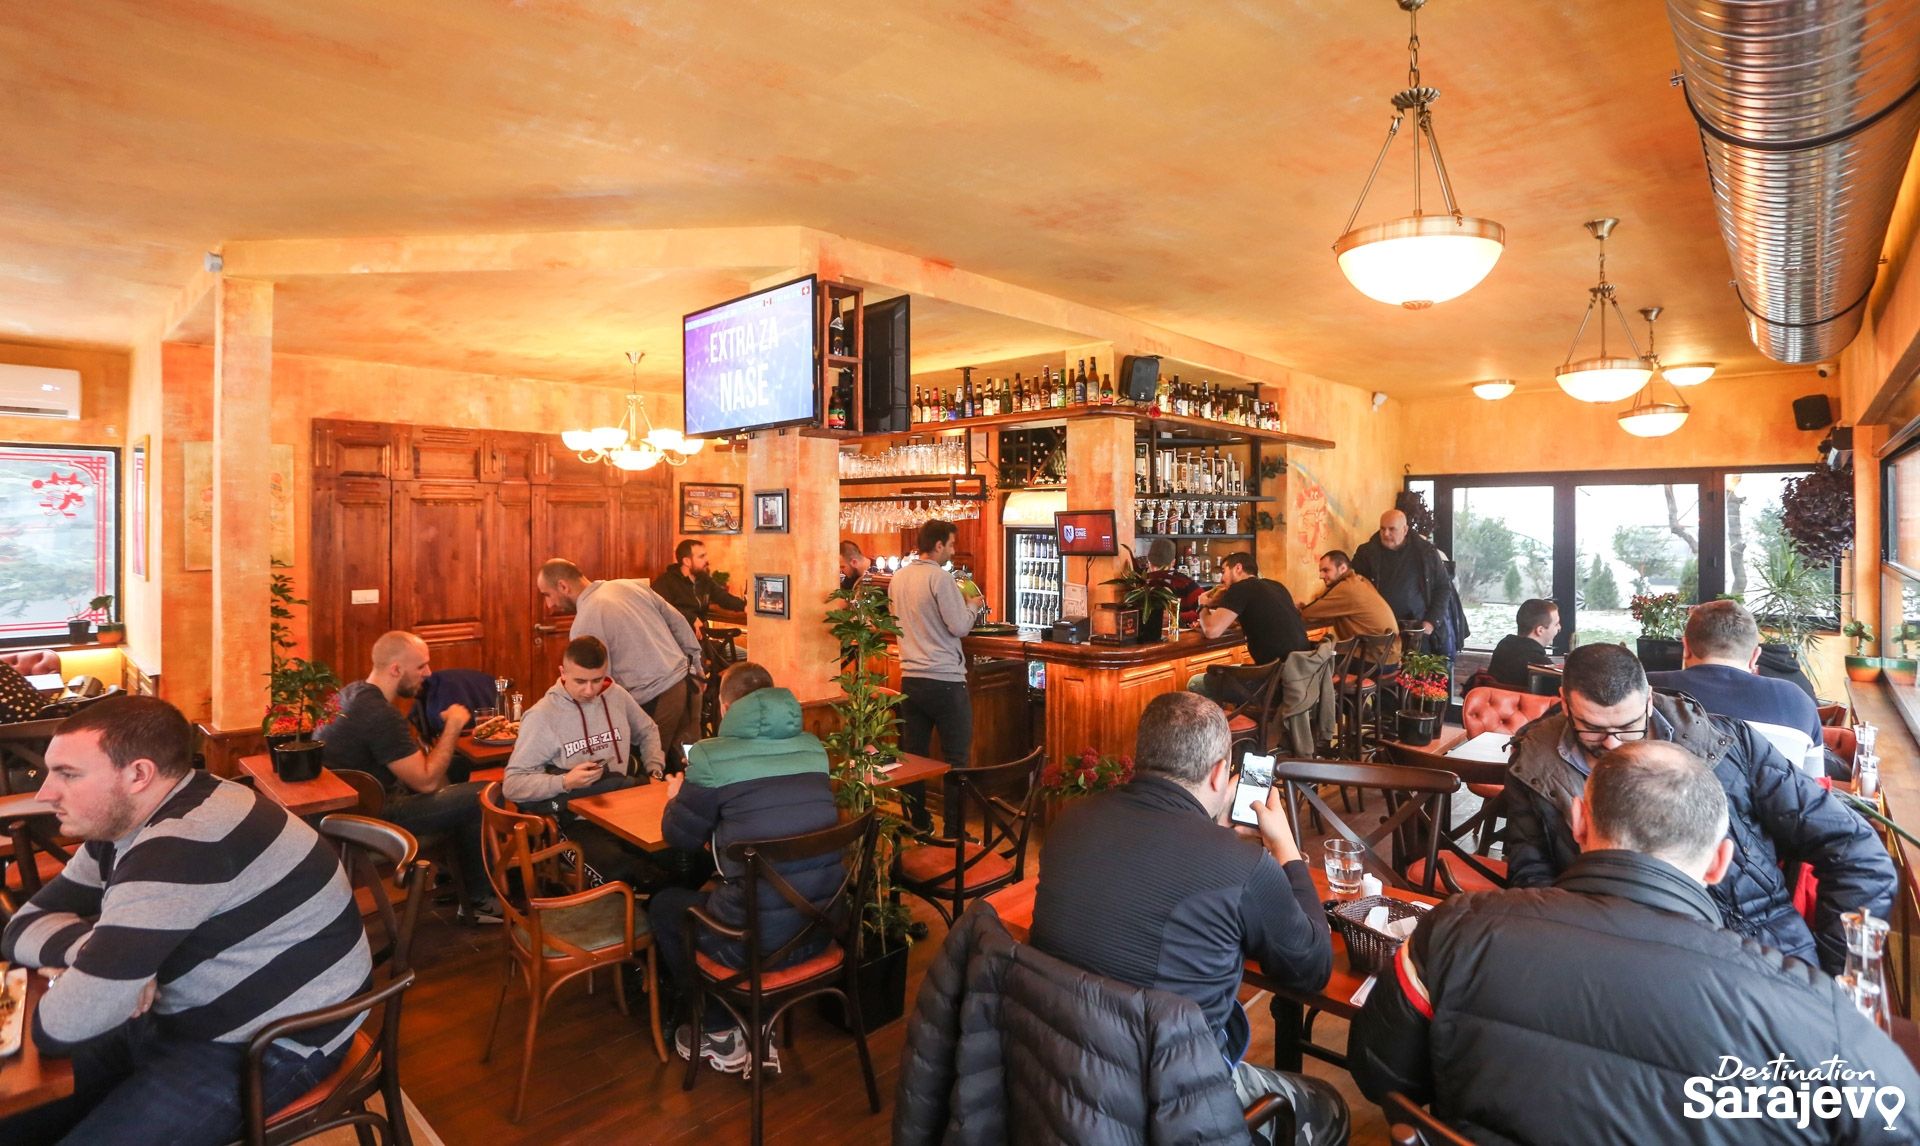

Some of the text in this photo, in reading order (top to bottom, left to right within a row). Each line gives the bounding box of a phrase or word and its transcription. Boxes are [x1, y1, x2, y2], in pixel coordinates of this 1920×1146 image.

[710, 316, 779, 363] EXTRA ZA
[720, 358, 768, 412] NAŠE
[582, 744, 609, 755] SAAJEVO
